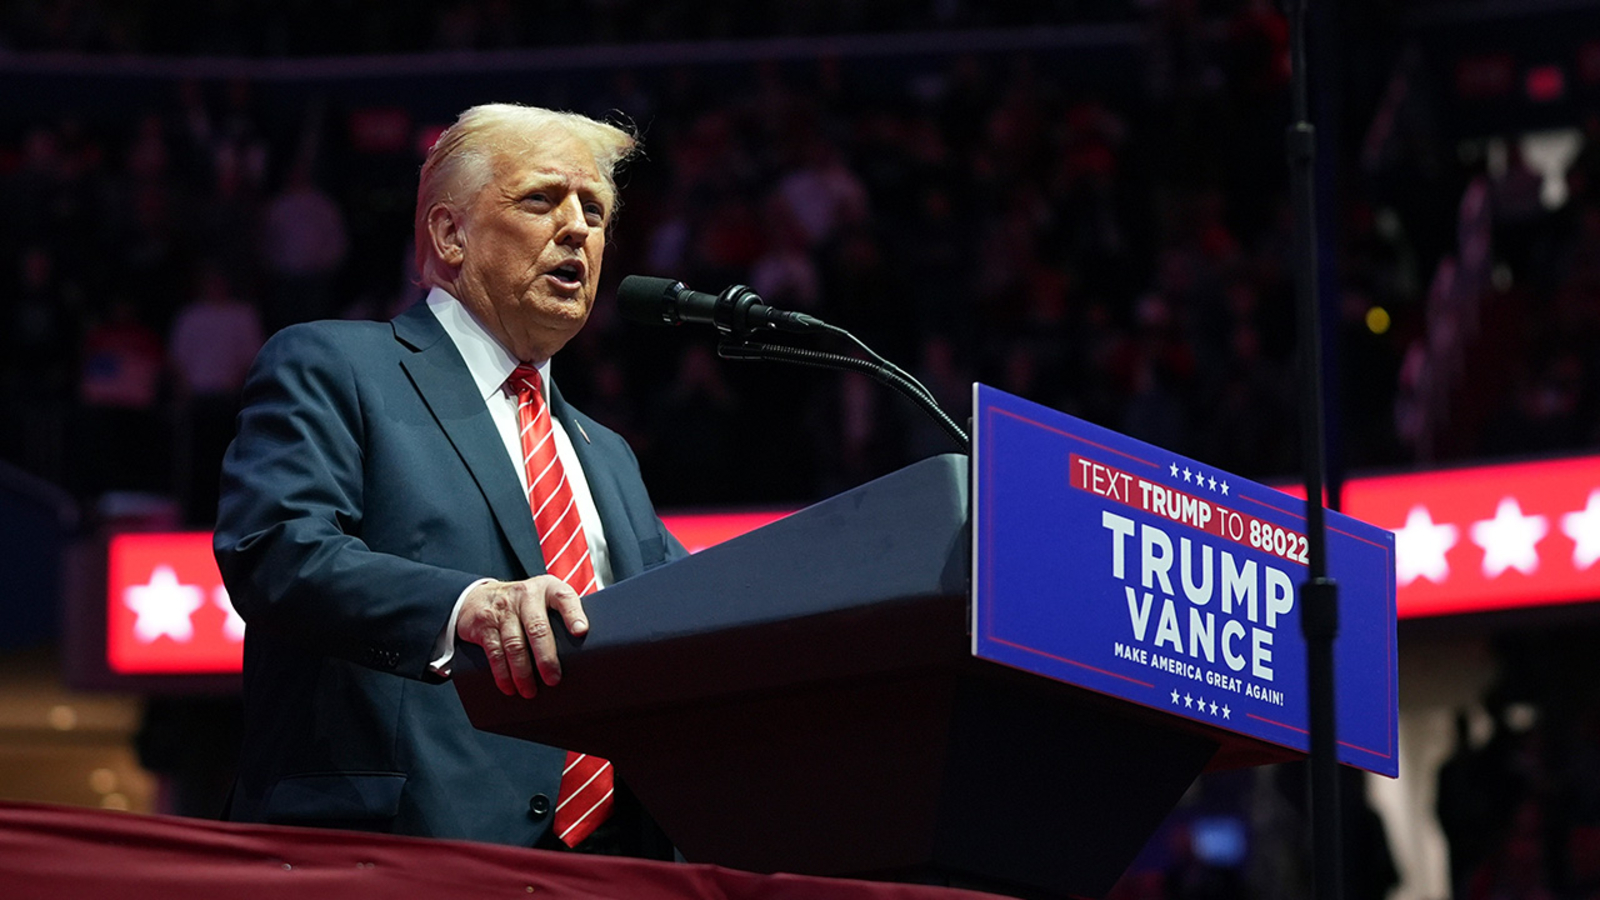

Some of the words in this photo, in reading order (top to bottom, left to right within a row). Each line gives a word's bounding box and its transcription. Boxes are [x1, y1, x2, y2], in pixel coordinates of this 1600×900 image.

[1078, 458, 1133, 503] TEXT
[1138, 479, 1212, 529] TRUMP
[1216, 506, 1244, 541] TO
[1249, 519, 1310, 565] 88022
[1102, 510, 1294, 629] TRUMP
[1114, 641, 1148, 665] MAKE
[1150, 653, 1203, 682] AMERICA
[1205, 670, 1243, 694] GREAT
[1245, 682, 1284, 707] AGAIN!
[1125, 585, 1274, 682] VANCE
